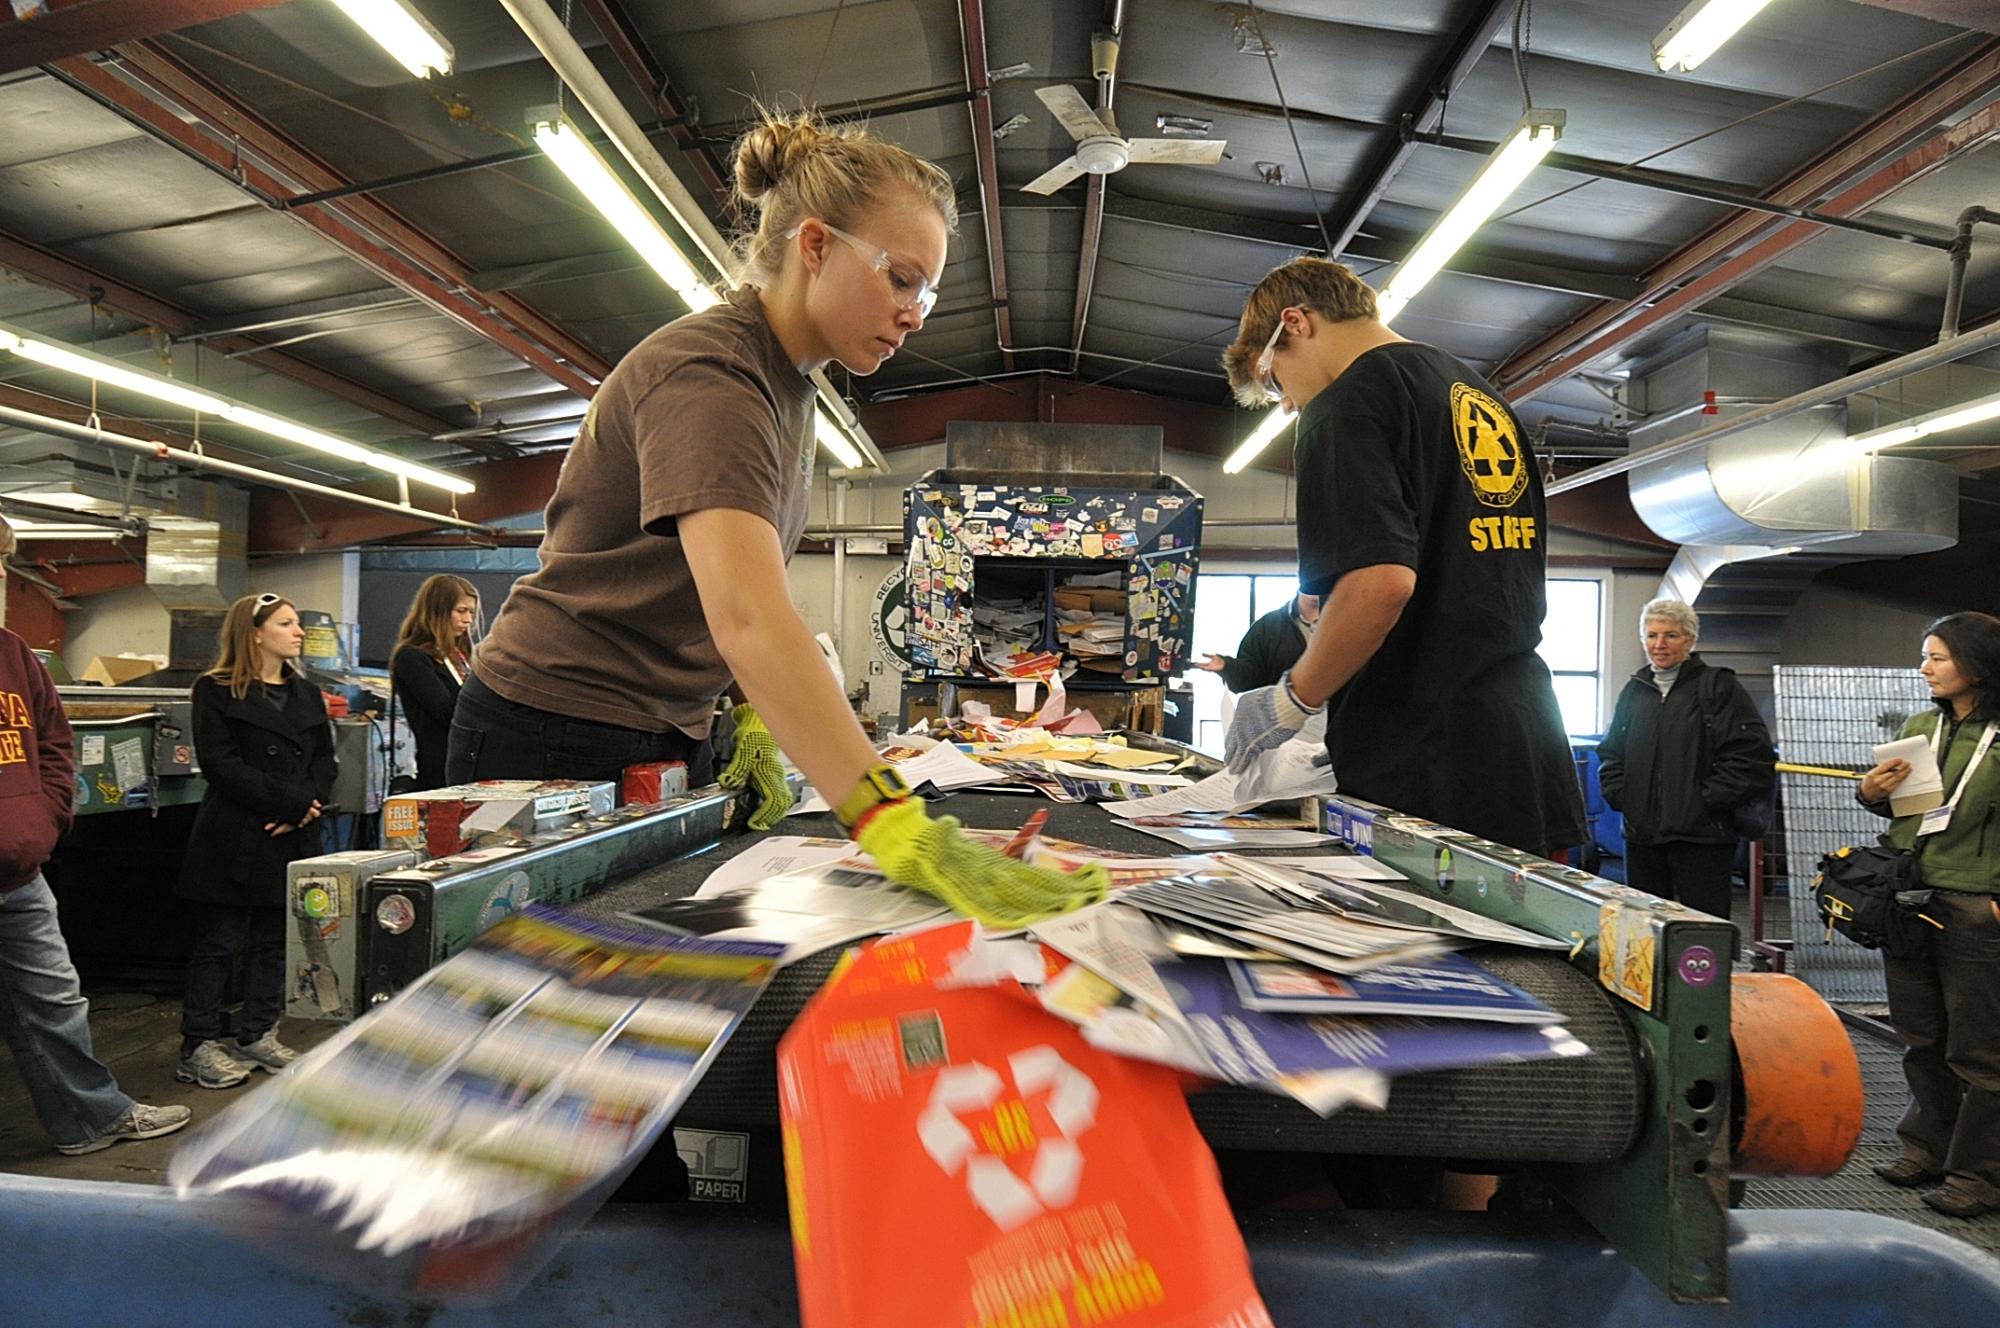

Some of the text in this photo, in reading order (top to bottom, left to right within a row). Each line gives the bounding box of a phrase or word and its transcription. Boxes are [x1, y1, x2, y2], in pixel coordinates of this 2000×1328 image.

[387, 805, 414, 819] FREE
[388, 819, 414, 831] ISSUE
[695, 1181, 740, 1199] PAPER
